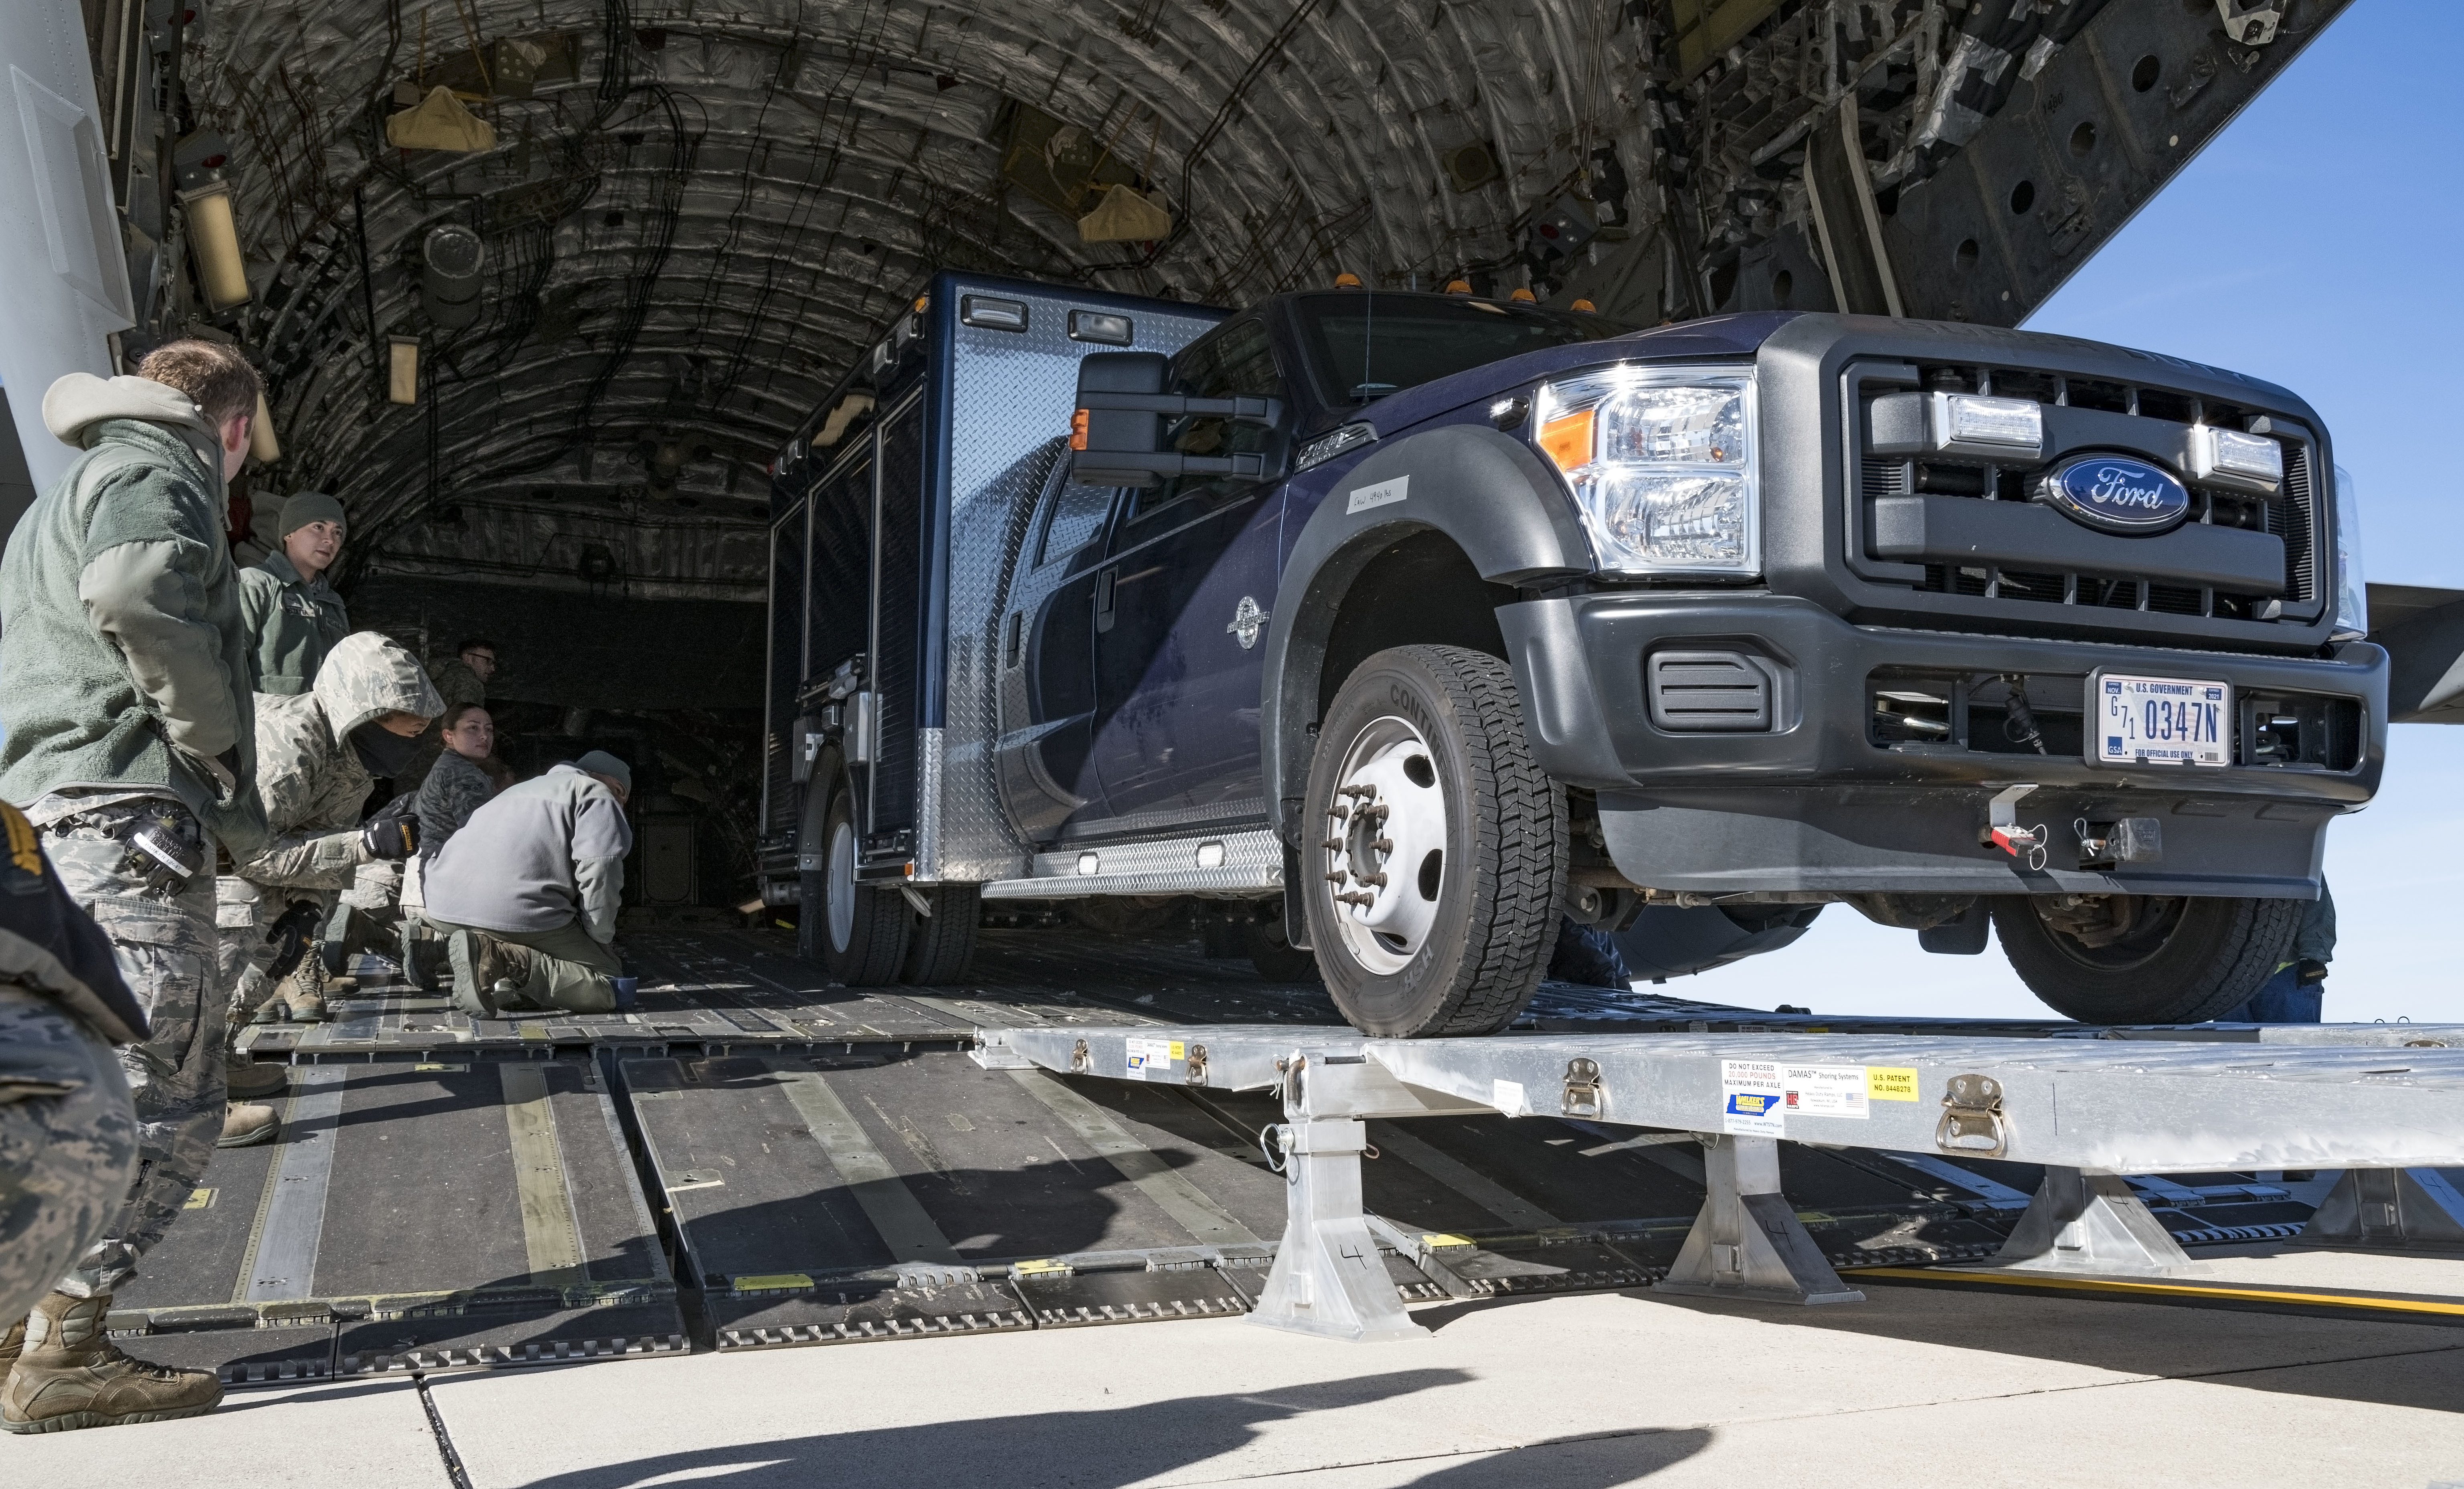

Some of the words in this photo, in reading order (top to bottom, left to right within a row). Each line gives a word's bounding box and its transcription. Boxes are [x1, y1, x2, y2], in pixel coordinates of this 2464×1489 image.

[2091, 467, 2163, 510] Ford
[2136, 683, 2148, 693] U.S.
[2150, 684, 2193, 695] GOVERNMENT
[2146, 700, 2217, 742] 0347N
[2147, 749, 2169, 758] OFFICIAL
[2170, 750, 2180, 758] USE
[166, 859, 182, 870] 12647
[2106, 1190, 2134, 1214] 4
[1765, 1220, 1795, 1252] 4
[1340, 1244, 1368, 1270] 4
